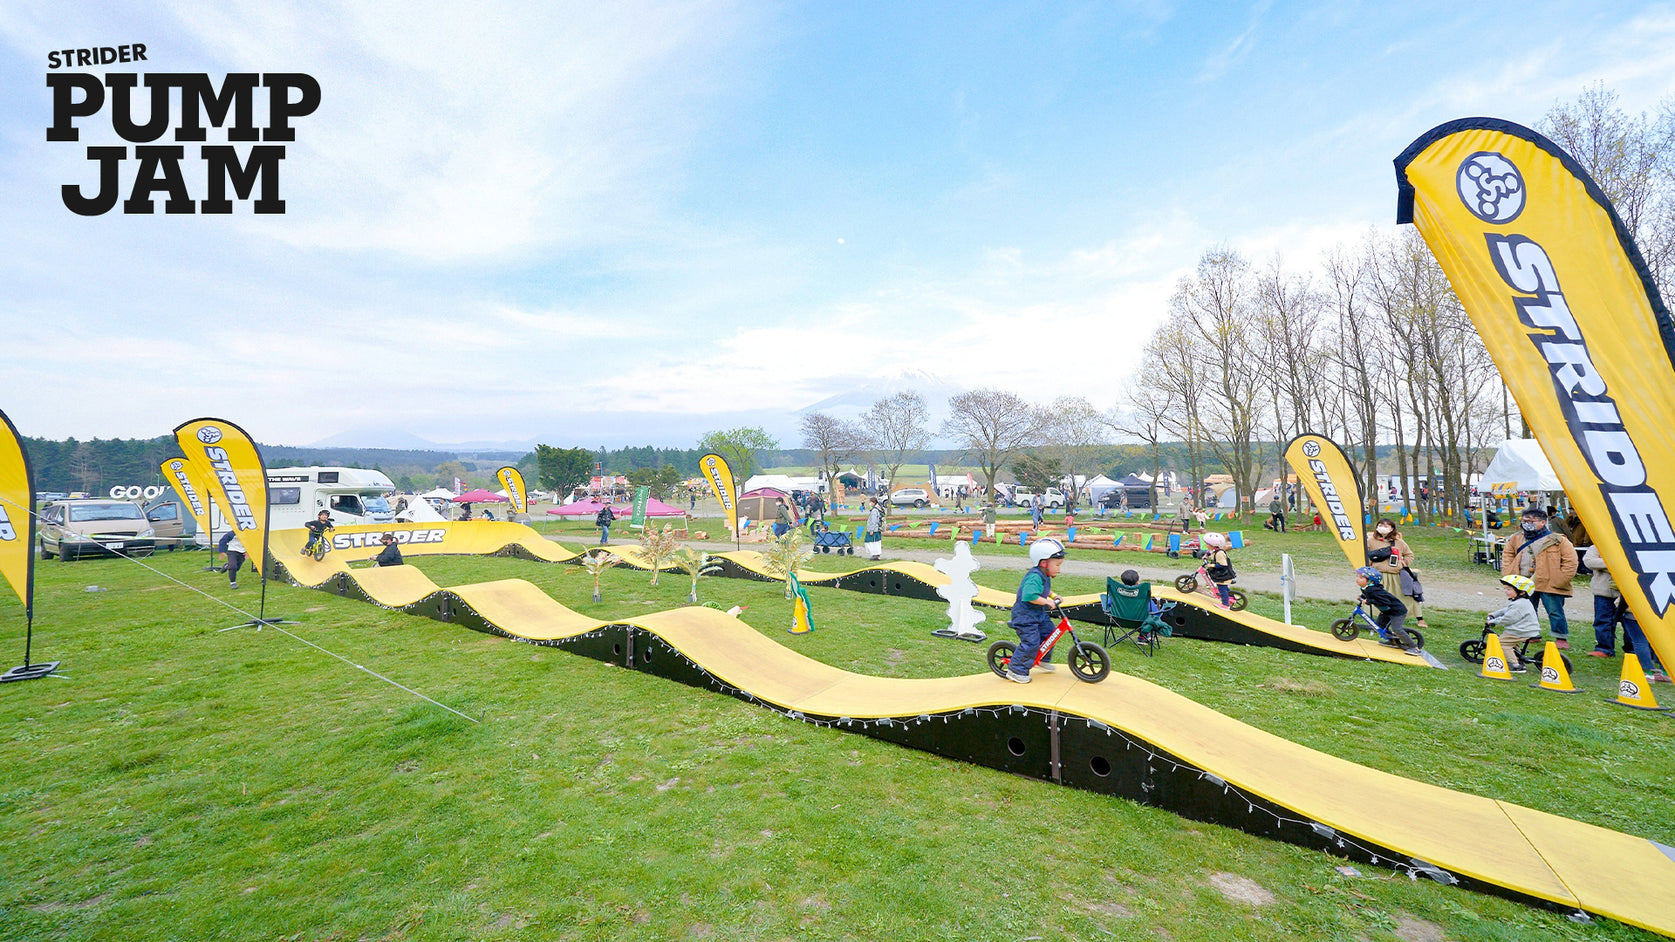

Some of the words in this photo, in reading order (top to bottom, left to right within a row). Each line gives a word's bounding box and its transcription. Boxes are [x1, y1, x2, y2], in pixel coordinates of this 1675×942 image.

[1485, 233, 1675, 617] STRIDER
[175, 471, 205, 516] STRIDER
[204, 446, 257, 531] STRIDER
[709, 467, 733, 510] STRIDER
[1308, 459, 1356, 541] STRIDER
[333, 529, 446, 550] STRDER
[1039, 627, 1062, 653] STRIDER
